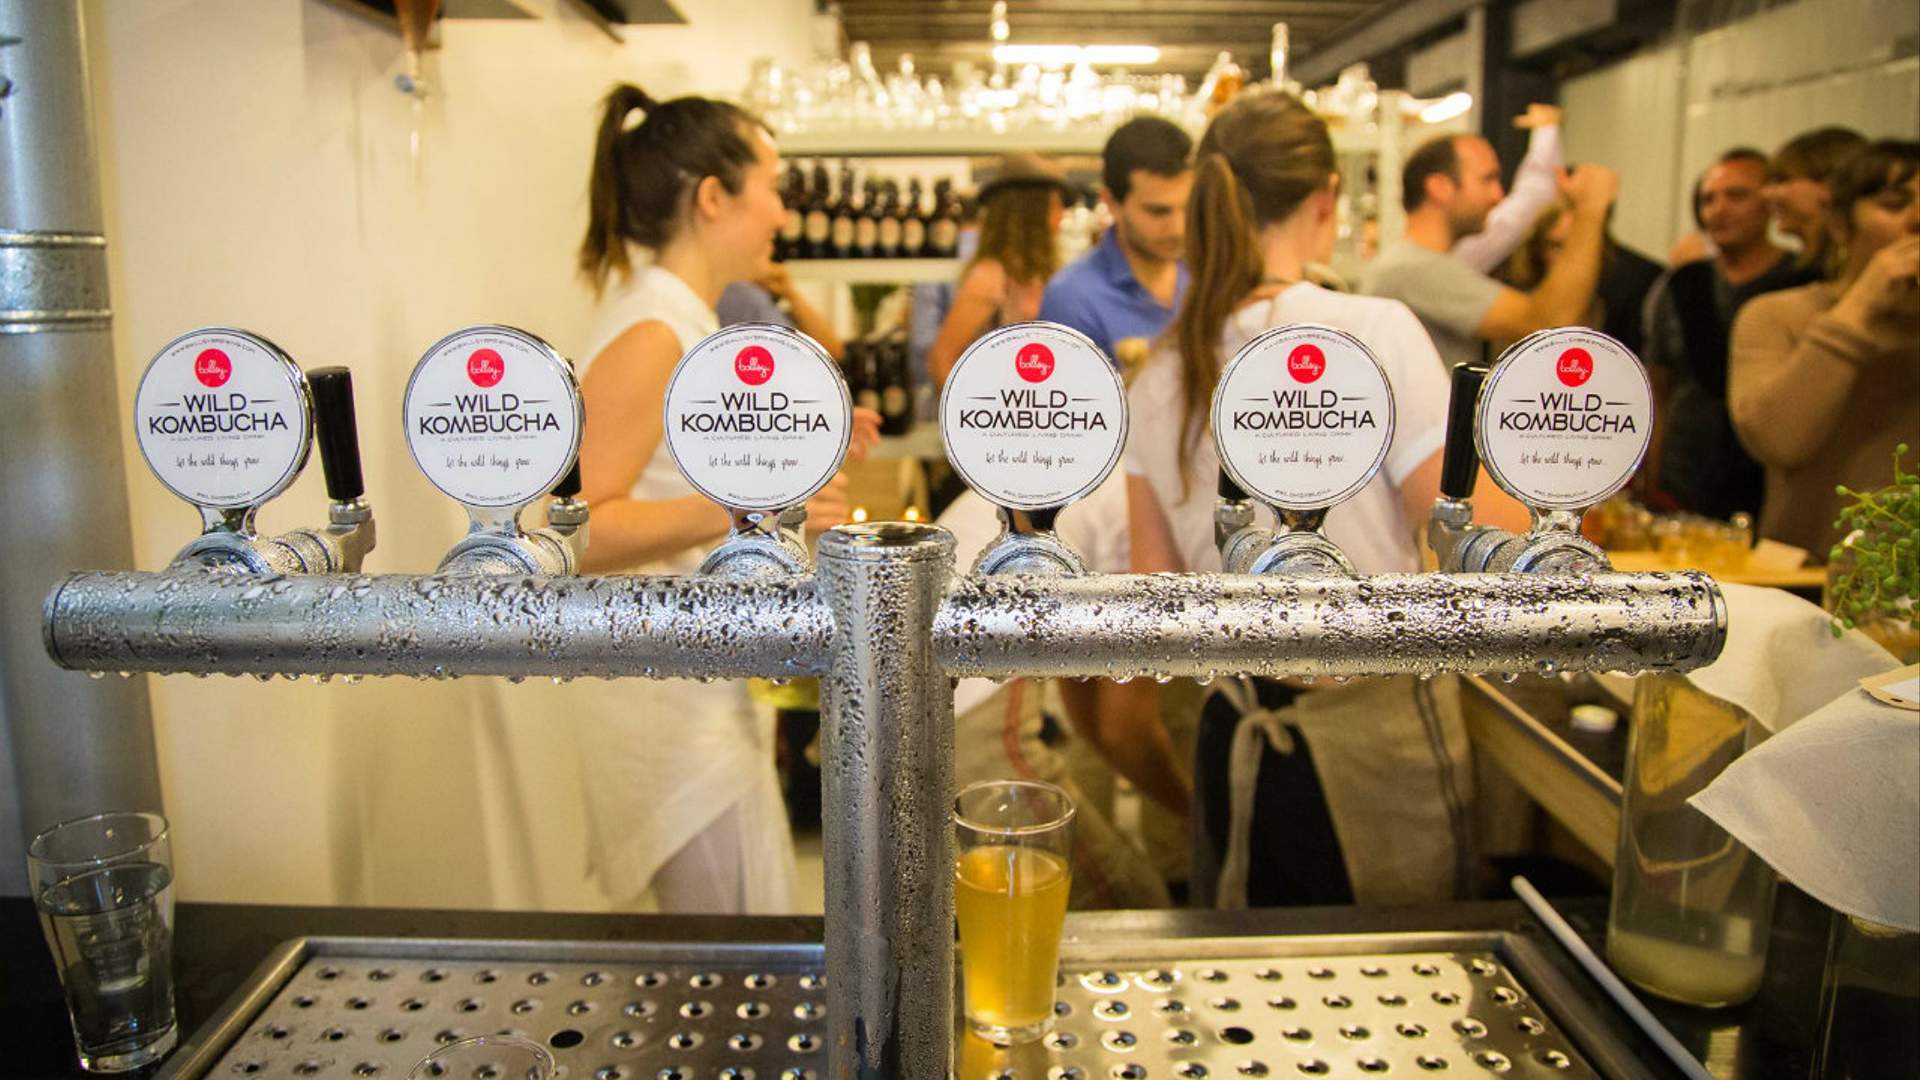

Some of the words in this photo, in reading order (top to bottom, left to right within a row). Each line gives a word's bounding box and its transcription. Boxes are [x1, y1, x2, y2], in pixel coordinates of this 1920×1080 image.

[183, 393, 247, 412] WILD
[455, 393, 519, 412] WILD
[721, 392, 789, 411] WILD
[1001, 389, 1068, 409] WILD
[1273, 390, 1338, 409] WILD
[1540, 392, 1601, 412] WILD
[149, 412, 288, 434] KOMBUCHA
[420, 413, 560, 435] KOMBUCHA
[681, 413, 830, 432] KOMBUCHA
[960, 410, 1107, 431] KOMBUCHA
[1234, 410, 1376, 430] KOMBUCHA
[1500, 412, 1636, 434] KOMBUCHA
[187, 453, 197, 467] the
[201, 454, 215, 467] wild
[220, 453, 239, 472] things
[458, 453, 467, 467] the
[471, 453, 485, 467] wild
[490, 453, 509, 472] things
[721, 453, 731, 467] the
[735, 453, 751, 467] wild
[755, 454, 776, 473] things
[999, 450, 1008, 464] the
[1012, 451, 1028, 464] wild
[1033, 451, 1052, 470] things
[1270, 450, 1280, 464] the
[1284, 450, 1298, 463] wild
[1303, 451, 1323, 469] things
[1532, 451, 1541, 465] the
[1544, 452, 1559, 465] wild
[1563, 452, 1582, 471] things
